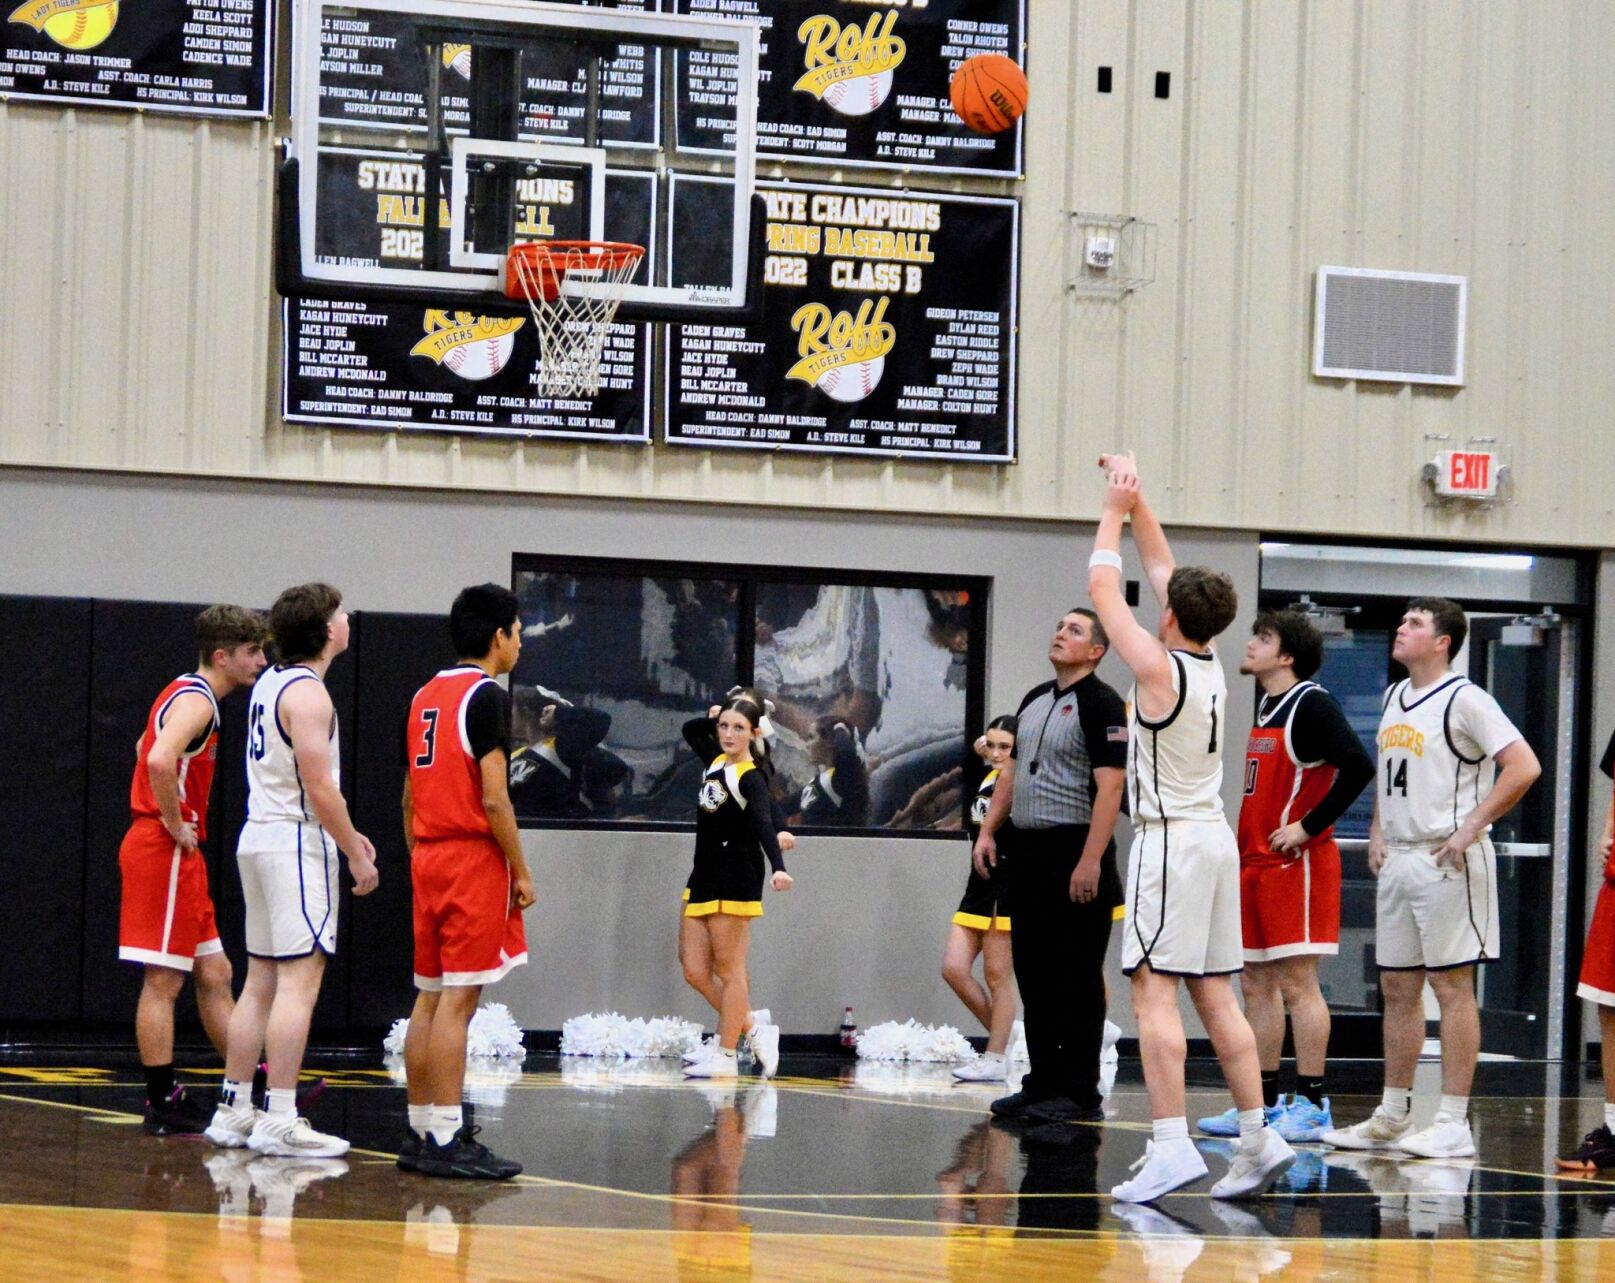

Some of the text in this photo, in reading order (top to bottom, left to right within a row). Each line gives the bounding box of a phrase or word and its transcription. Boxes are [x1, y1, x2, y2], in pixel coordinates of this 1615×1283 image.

[221, 0, 254, 11] OWENS
[193, 9, 253, 25] KEELA SCOTT
[183, 22, 253, 39] ADDI SHEPPARD
[332, 19, 370, 33] HUDSON
[947, 19, 1009, 35] CONNER OWENS
[184, 36, 252, 53] CAMDEN SIMON
[341, 34, 397, 49] HUNEYCUTT
[948, 33, 1008, 48] TALON RHOTEN
[6, 48, 132, 69] HEAD COACH: JASON TRIMMER
[182, 50, 252, 67] CADENCE WADE
[327, 48, 360, 60] JOPLIN
[618, 45, 644, 57] WEBB
[689, 50, 710, 63] COLE
[941, 45, 964, 57] DREW
[15, 62, 47, 76] OWENS
[349, 62, 384, 76] MILLER
[609, 70, 644, 84] WILSON
[689, 64, 718, 77] KAGAN
[815, 65, 854, 86] TIGERS
[63, 80, 111, 95] STEVE KILE
[98, 70, 213, 90] ASST. COACH: CARLA HARRIS
[527, 77, 571, 91] MANAGER:
[689, 77, 737, 93] WIL JOPLIN
[193, 91, 248, 105] KIRK WILSON
[328, 86, 402, 102] PRINCIPAL HEAD
[689, 91, 727, 105] TRAYSON
[344, 102, 417, 117] SUPERINTENDENT:
[558, 106, 586, 118] DANNY
[524, 117, 570, 131] STEVE KILE
[824, 127, 847, 140] SIMON
[876, 131, 996, 150] ASST. DANNY BALDRIDGE
[793, 138, 847, 153] SCOTT MORGAN
[894, 147, 935, 161] STEVE KILE
[766, 190, 941, 231] ATE CHAMPIONS
[380, 227, 424, 260] 202
[766, 222, 936, 263] RING BASEBALL
[764, 255, 923, 294] 022 CLASS B
[299, 309, 388, 327] KAGAN HUNEYCUTT
[926, 307, 1000, 323] GIDEON PETERSEN
[299, 323, 348, 338] JACE HYDE
[681, 324, 746, 340] CADEN GRAVES
[949, 321, 1000, 336] DYLAN REED
[299, 337, 356, 353] BEAU JOPLIN
[434, 328, 474, 352] TIGERS
[612, 336, 635, 349] WADE
[681, 337, 766, 354] KAGAN HUNEYCUTT
[935, 334, 999, 350] EASTON RIDDLE
[299, 351, 368, 367] BILL MCCARTER
[603, 350, 635, 363] WILSON
[681, 351, 729, 365] JACE HYDE
[809, 351, 849, 374] TIGERS
[930, 347, 999, 362] DREW SHEPPARD
[299, 365, 387, 382] ANDREW MCDONALD
[612, 365, 634, 377] GORE
[680, 365, 736, 379] BEAU JOPLIN
[952, 361, 999, 376] ZEPH WADE
[609, 379, 634, 390] HUNT
[680, 378, 748, 394] BILL MCCARTER
[936, 374, 999, 389] BRAND WILSON
[325, 385, 593, 412] HEAD COACH: DANNY BALDRIDGE ASST. COACH: MATT BENEDICT
[680, 391, 766, 408] ANDREW MCDONALD
[903, 385, 999, 402] MANAGER: CADEN GORE
[299, 400, 616, 430] SUPERINTENDENT: EAD SIMON STEVE KILE KIRK WILSON
[897, 398, 998, 416] MANAGER: COLTON HUNT
[705, 410, 727, 422] HEAD
[757, 413, 785, 426] DANNY
[785, 414, 827, 428] BALDRIDGE
[849, 419, 870, 432] ASST.
[897, 421, 920, 434] MATT
[920, 422, 957, 436] BENEDICT
[681, 423, 982, 451] SUPERINTENDENT: SIMON STEVE KILE KIRK WILSON
[1450, 452, 1491, 490] EXIT
[1207, 693, 1218, 754] 1
[415, 708, 440, 769] 3
[1378, 723, 1425, 758] TIGERS
[1386, 757, 1408, 797] 14
